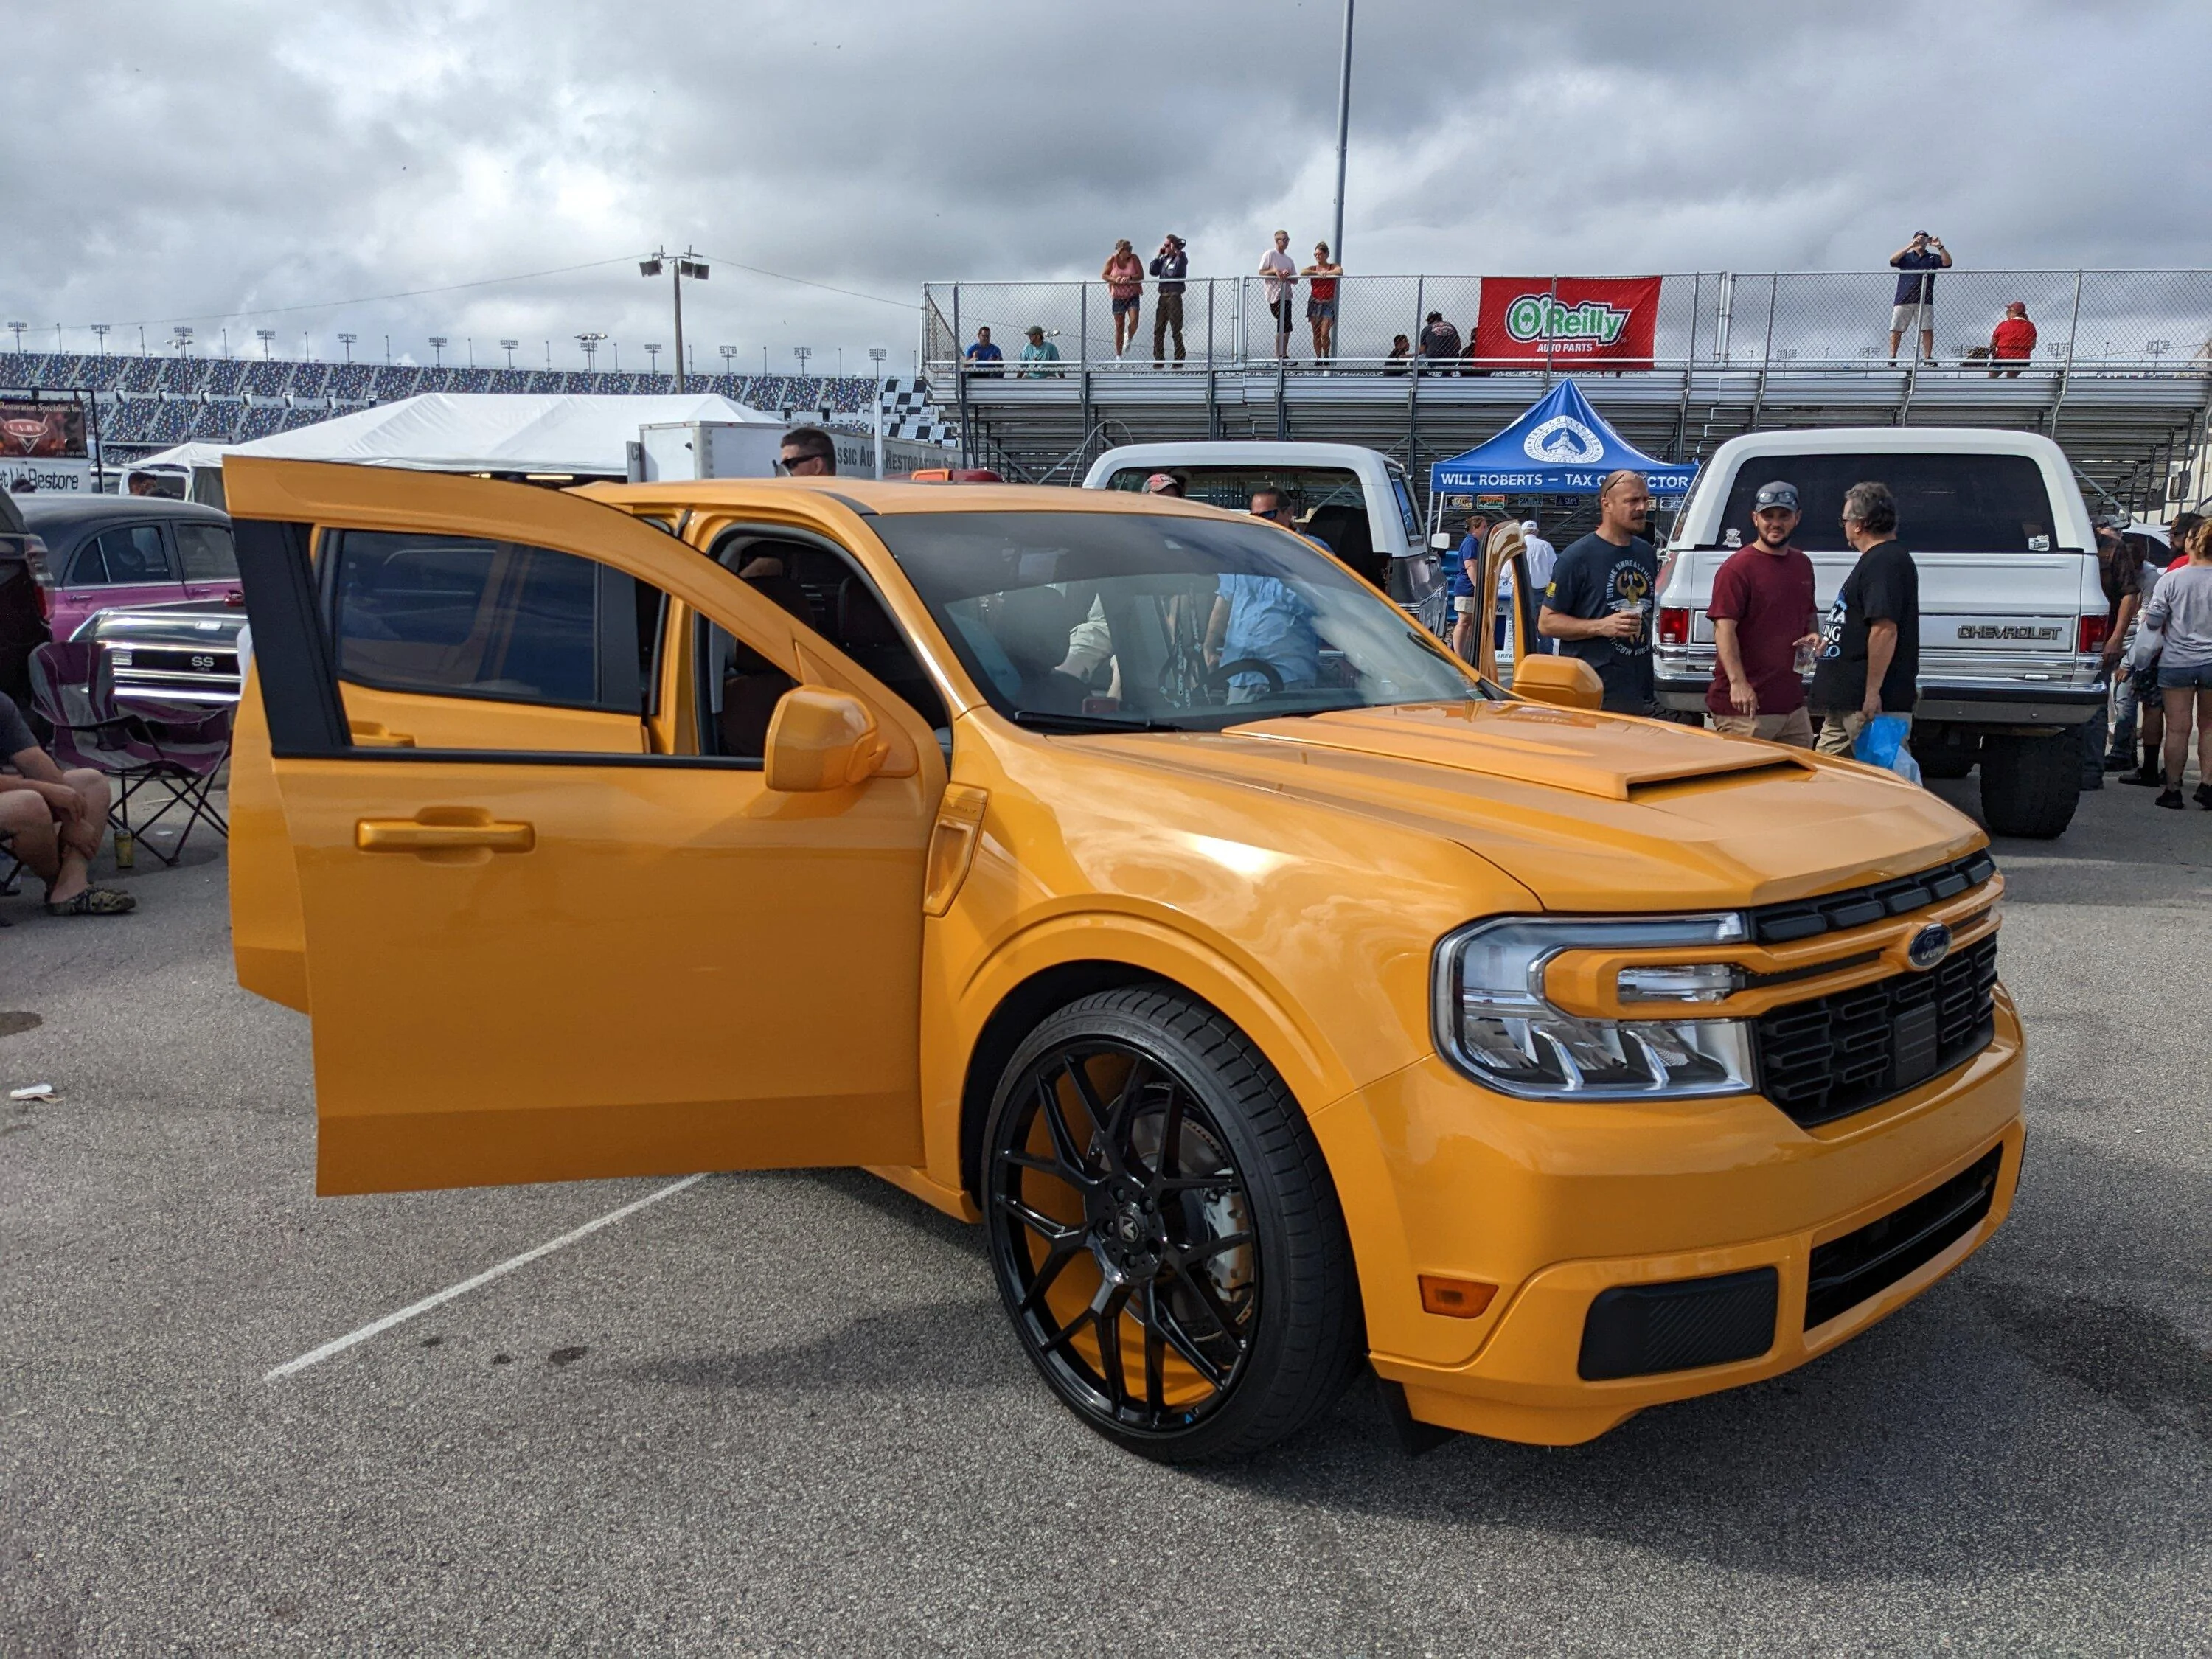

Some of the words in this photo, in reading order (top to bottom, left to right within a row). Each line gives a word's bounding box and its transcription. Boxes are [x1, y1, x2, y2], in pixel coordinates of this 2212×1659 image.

[1512, 299, 1621, 338] O'Reilly
[1537, 342, 1561, 352] AUTO
[1562, 343, 1593, 352] PARTS
[29, 468, 79, 490] Restore
[1441, 473, 1474, 486] WILL
[1479, 474, 1543, 486] ROBERTS
[1565, 474, 1593, 486] TAX
[1958, 625, 2062, 640] CHEVROLET
[192, 656, 215, 667] SS
[1921, 933, 1947, 960] Ford
